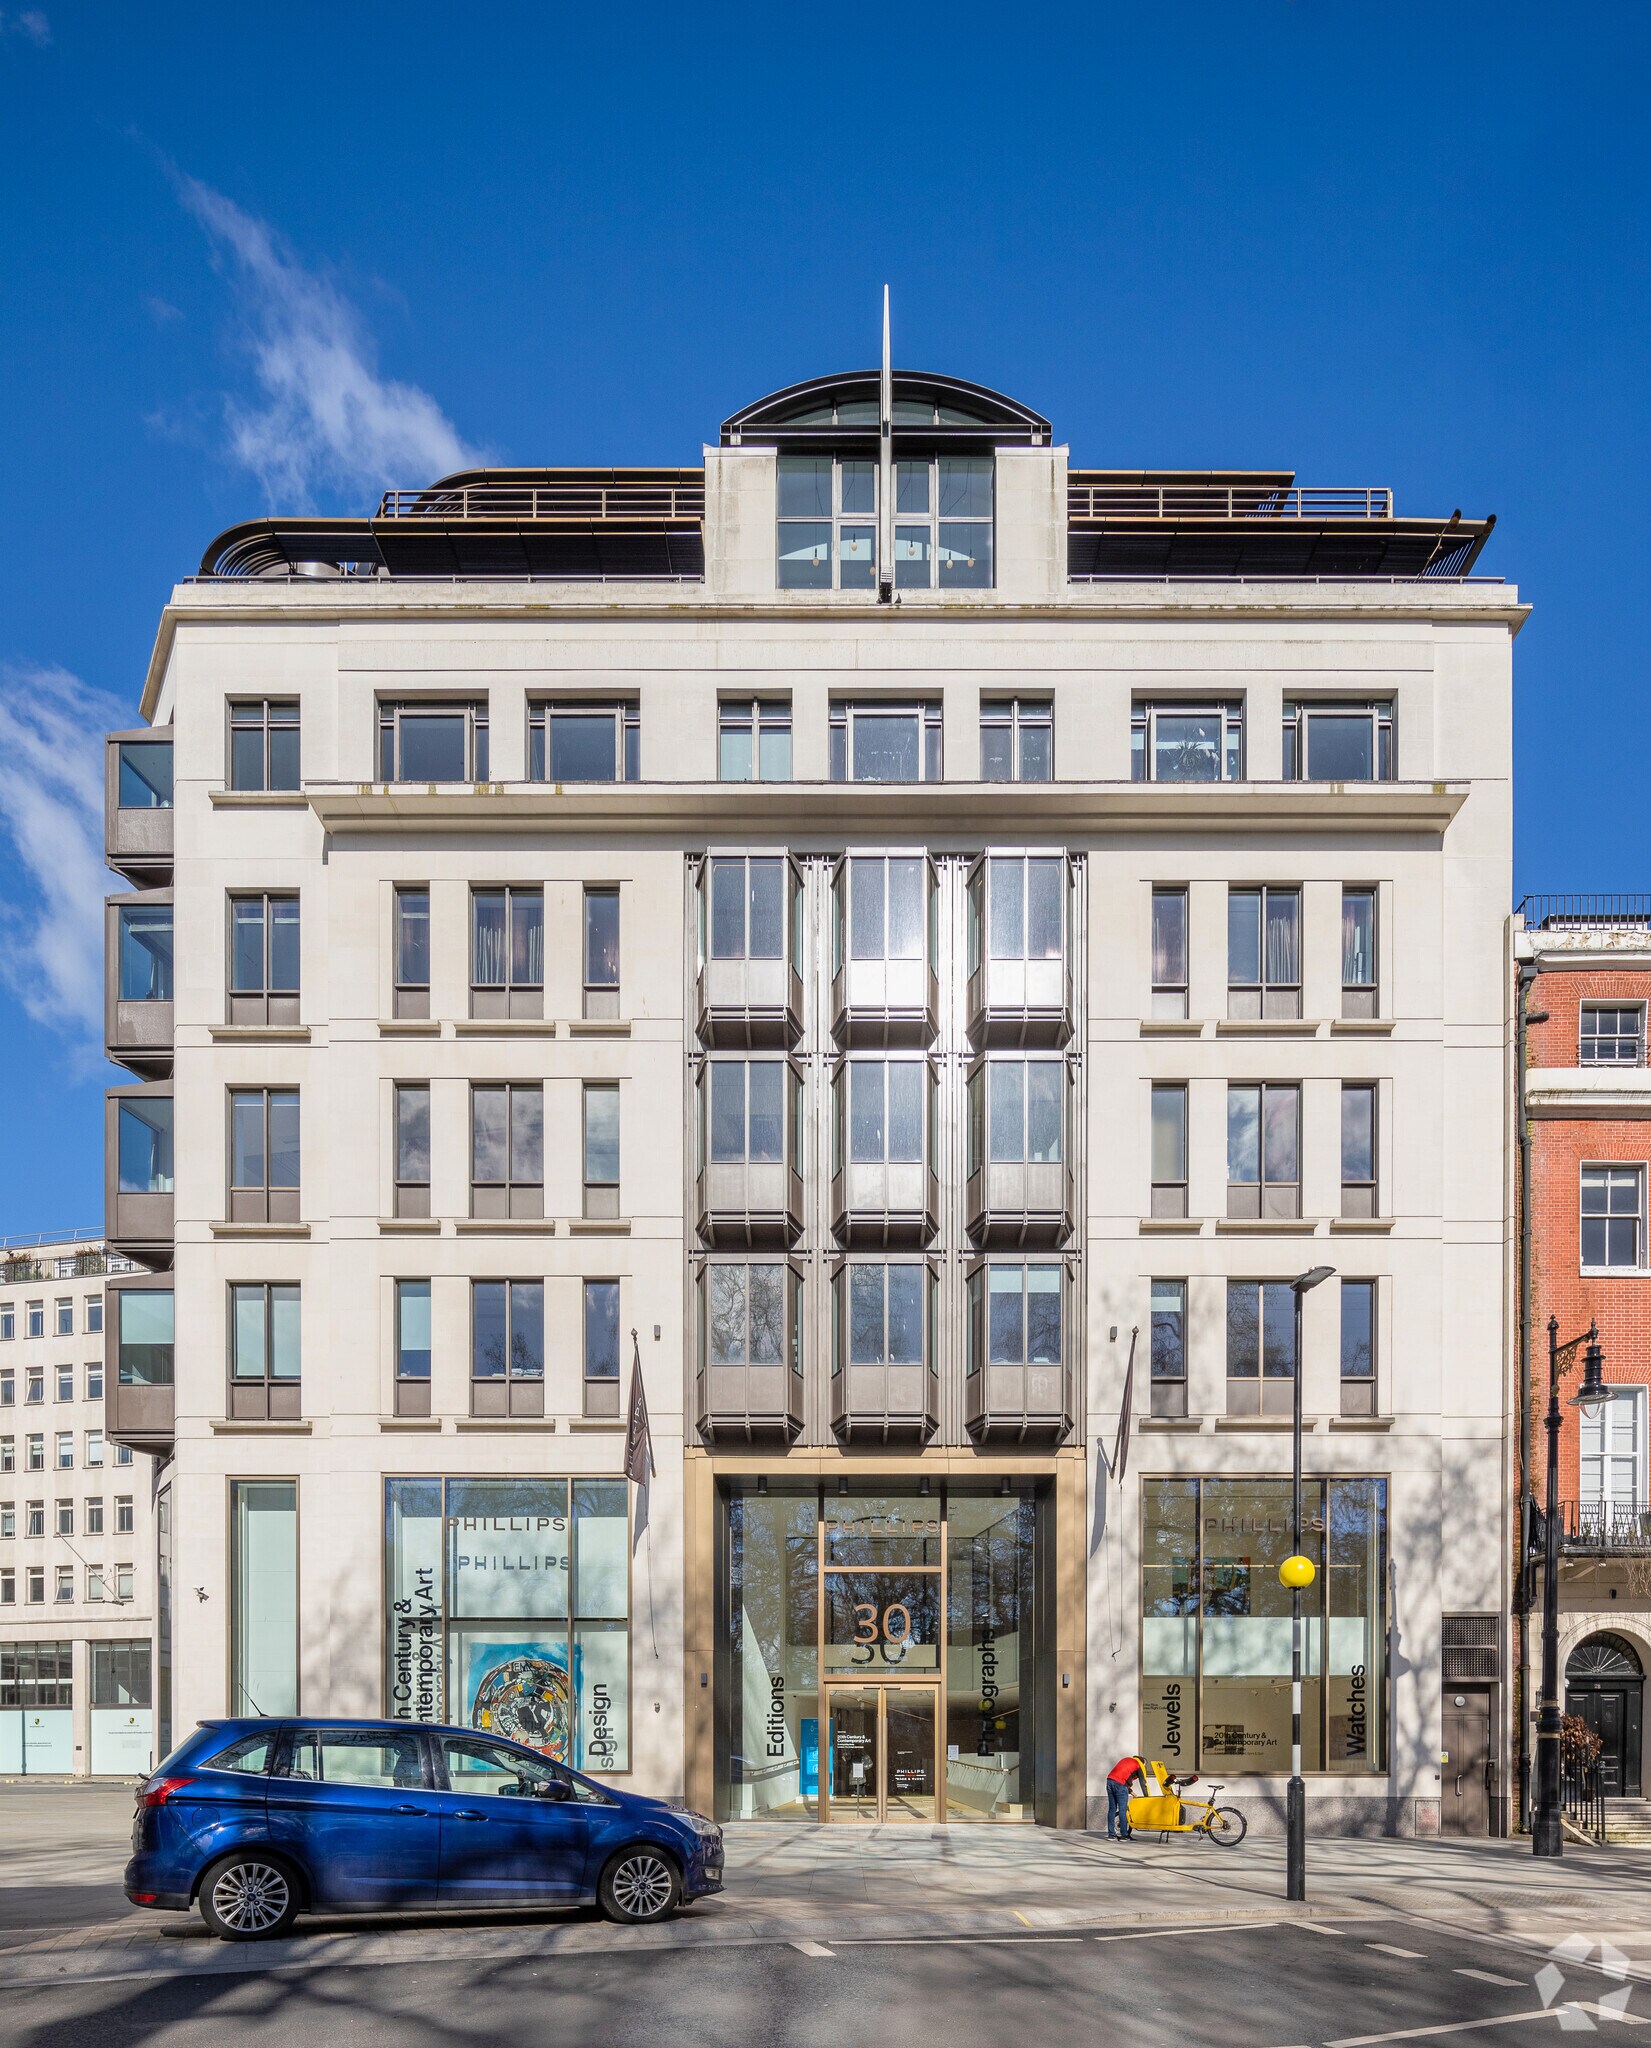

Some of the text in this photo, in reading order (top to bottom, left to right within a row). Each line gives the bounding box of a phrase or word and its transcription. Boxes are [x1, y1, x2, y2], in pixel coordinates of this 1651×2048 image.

[447, 1517, 566, 1532] PHILLIPS
[825, 1520, 940, 1534] PHILLIPS
[393, 1598, 412, 1614] &
[853, 1603, 911, 1644] 30
[393, 1617, 415, 1702] Century
[414, 1567, 437, 1723] ntemporary Art
[589, 1683, 611, 1756] Design
[766, 1676, 785, 1757] Editions
[1162, 1683, 1181, 1757] Jewels
[1232, 1732, 1260, 1740] Century
[1346, 1664, 1366, 1757] Watches
